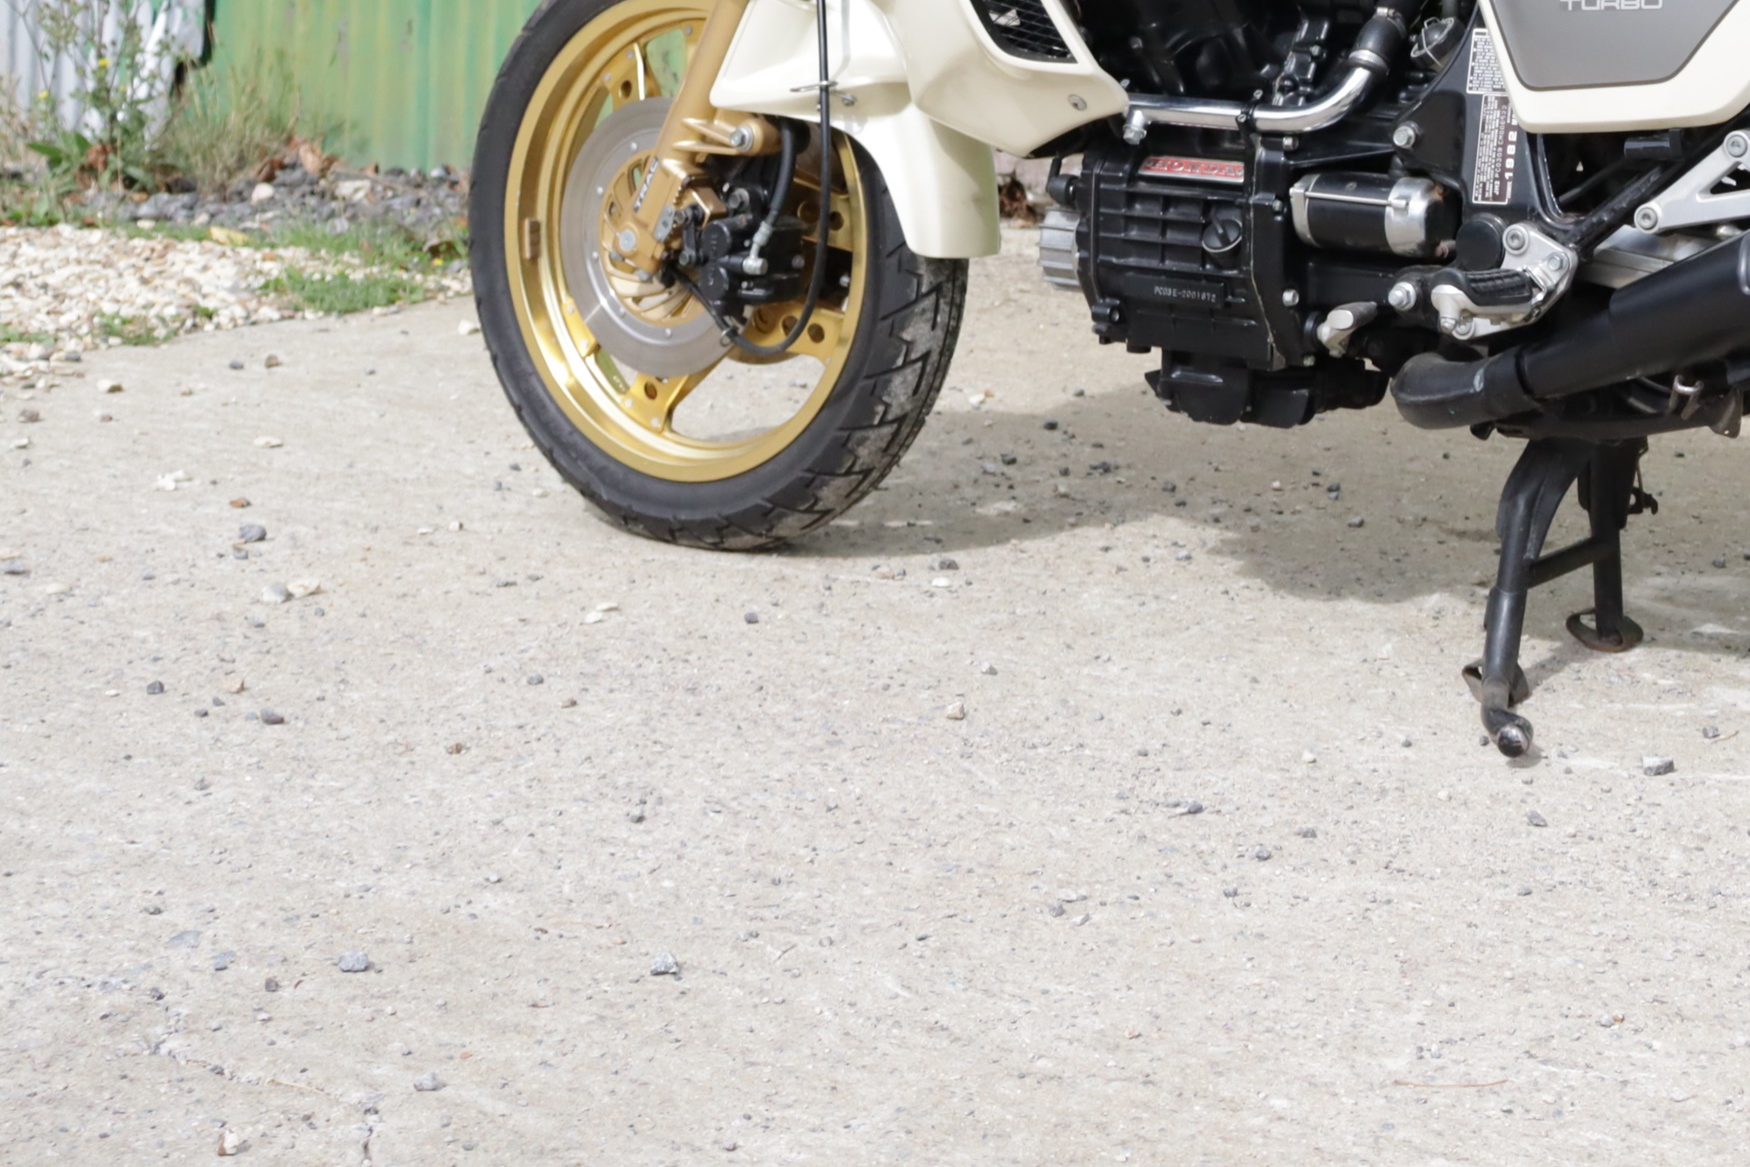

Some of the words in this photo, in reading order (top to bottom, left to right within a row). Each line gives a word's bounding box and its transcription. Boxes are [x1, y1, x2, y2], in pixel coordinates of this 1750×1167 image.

[1155, 159, 1236, 177] HONDA
[1504, 131, 1518, 180] 1982
[634, 157, 659, 210] TRAC
